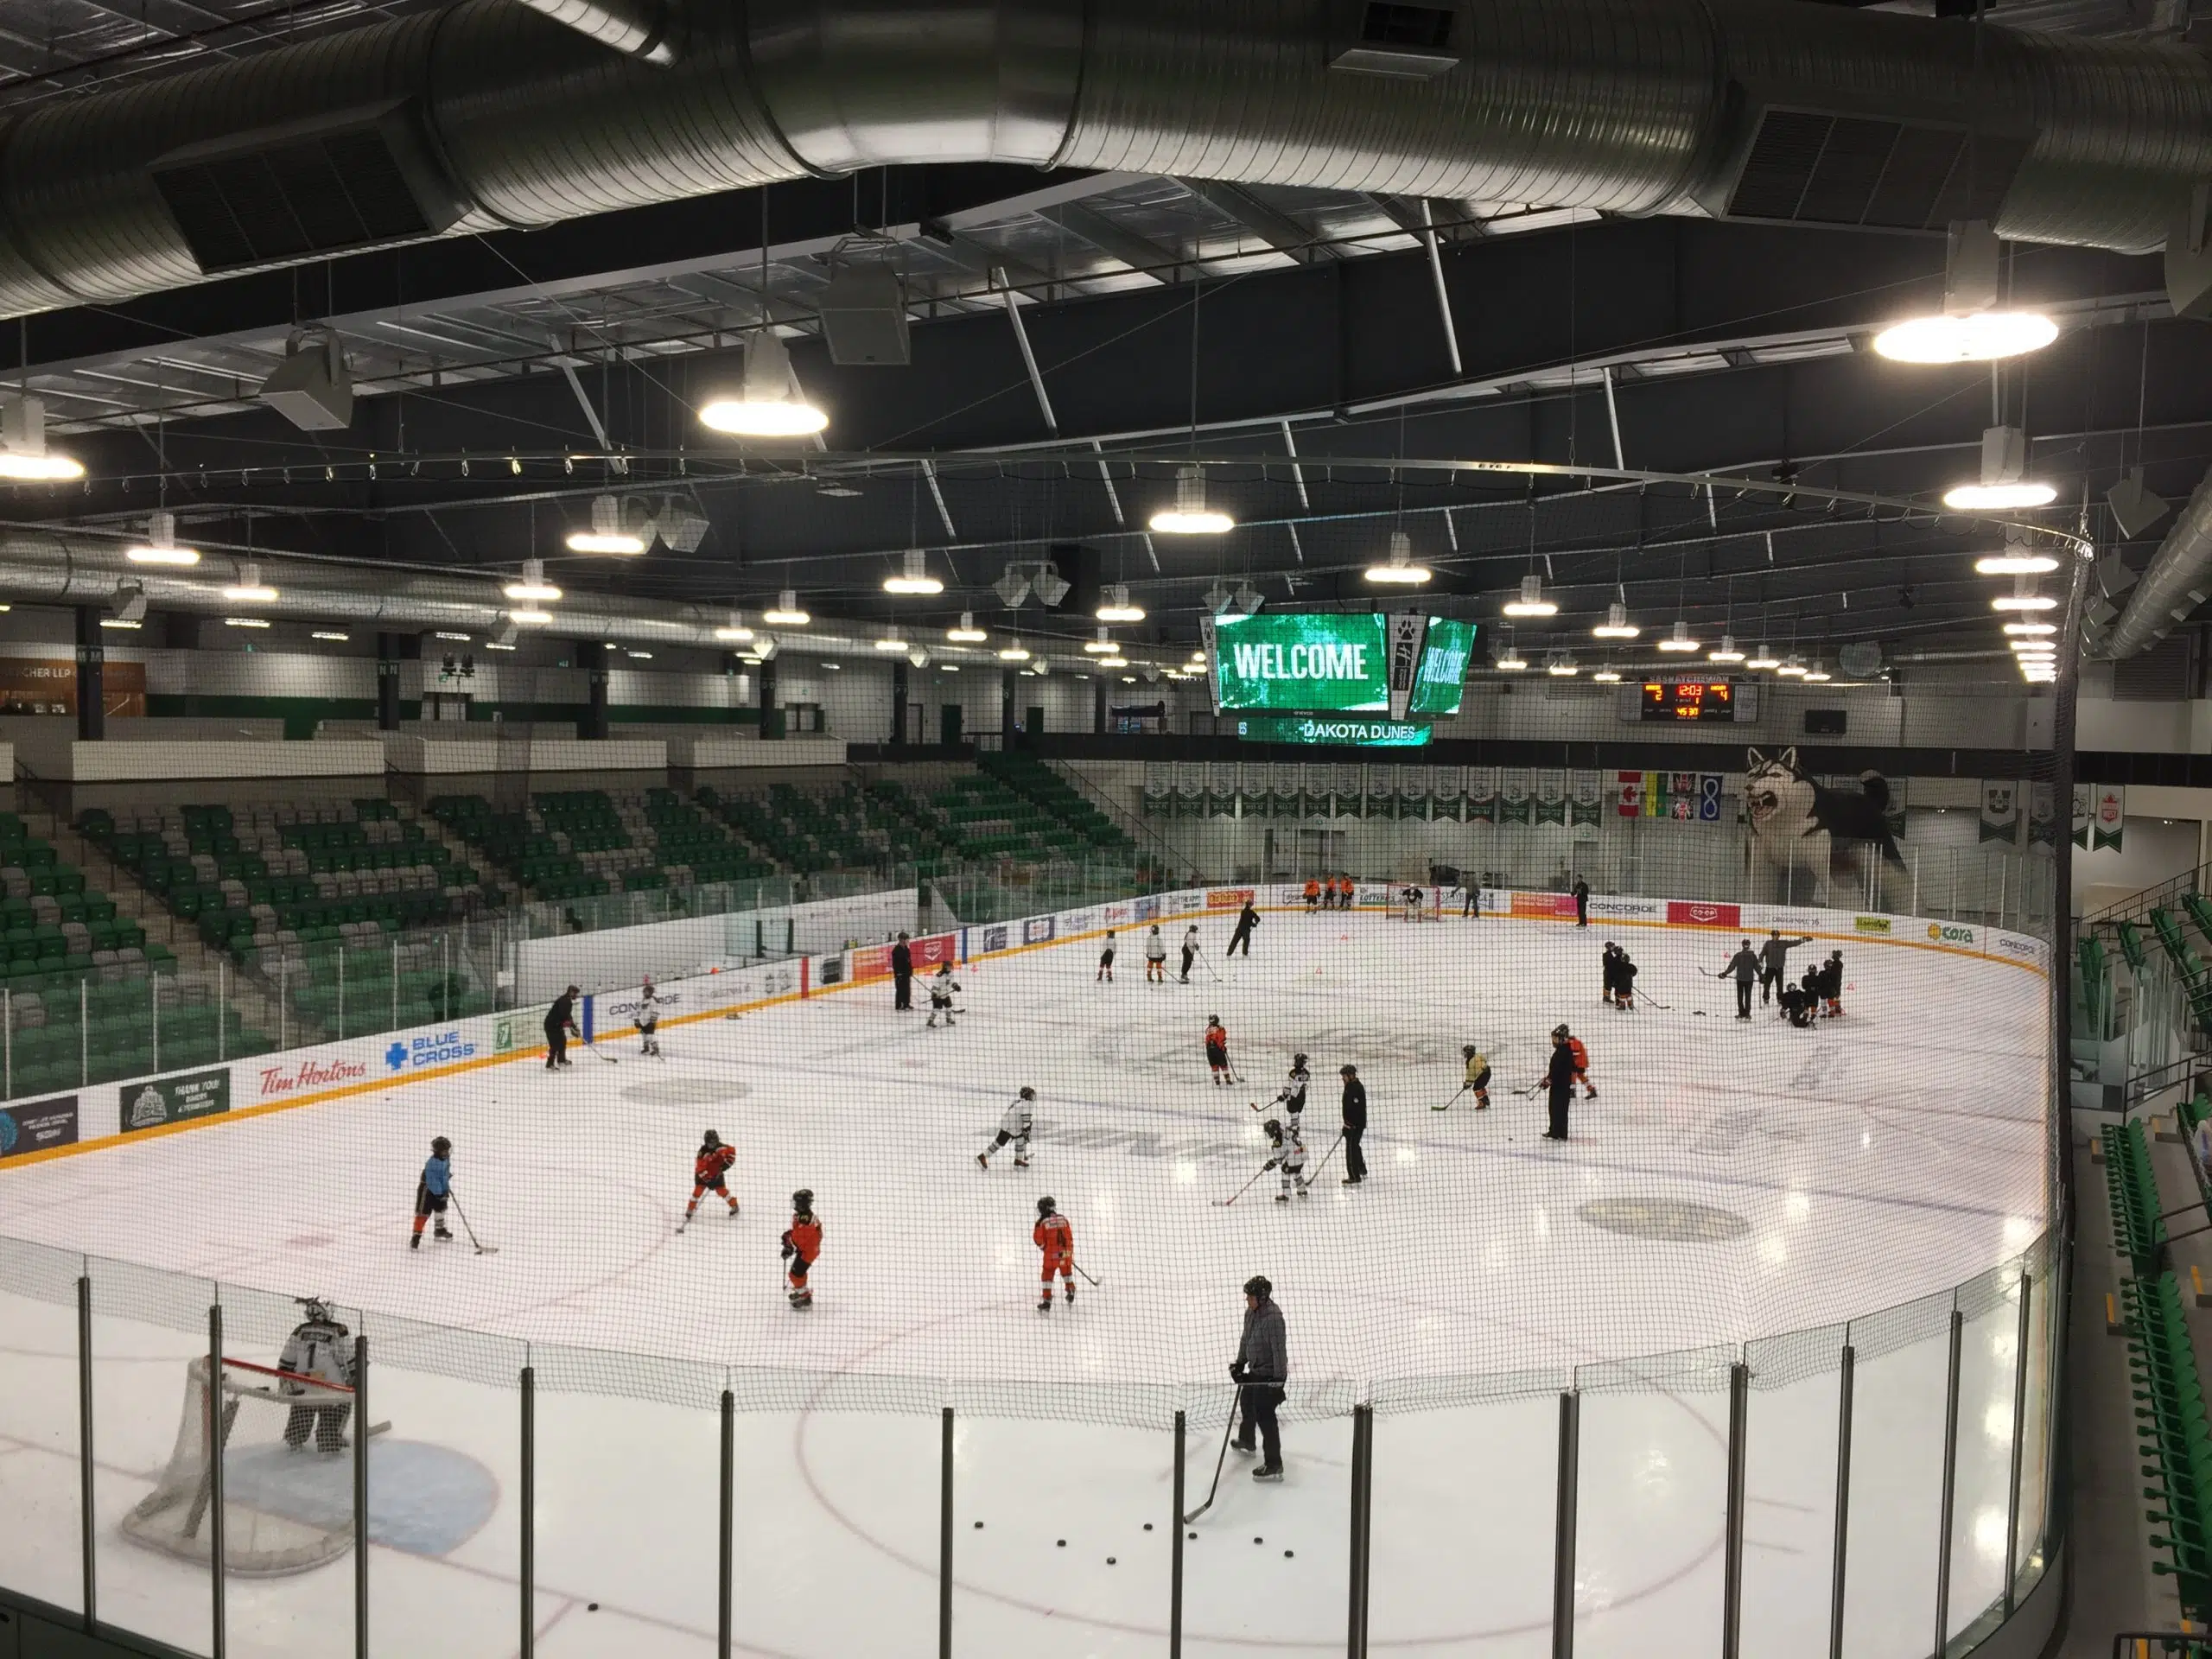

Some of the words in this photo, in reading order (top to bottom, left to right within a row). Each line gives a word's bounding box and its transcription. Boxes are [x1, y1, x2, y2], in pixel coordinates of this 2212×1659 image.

[1234, 644, 1369, 680] WELCOME
[1423, 647, 1466, 684] WELCOME
[53, 668, 71, 678] LLP
[1655, 690, 1662, 701] 2
[1679, 685, 1702, 696] 12:03
[1719, 690, 1728, 701] 4
[1303, 724, 1368, 739] DAKOTA
[1370, 725, 1416, 740] DUNES
[1589, 903, 1656, 913] CONCORDE
[1942, 925, 1974, 944] cora
[412, 1031, 460, 1051] BLUE
[412, 1043, 475, 1066] CROSS
[260, 1065, 294, 1096] Tim
[296, 1058, 366, 1090] Hortons
[175, 1083, 200, 1096] THANK
[307, 1342, 317, 1369] 1
